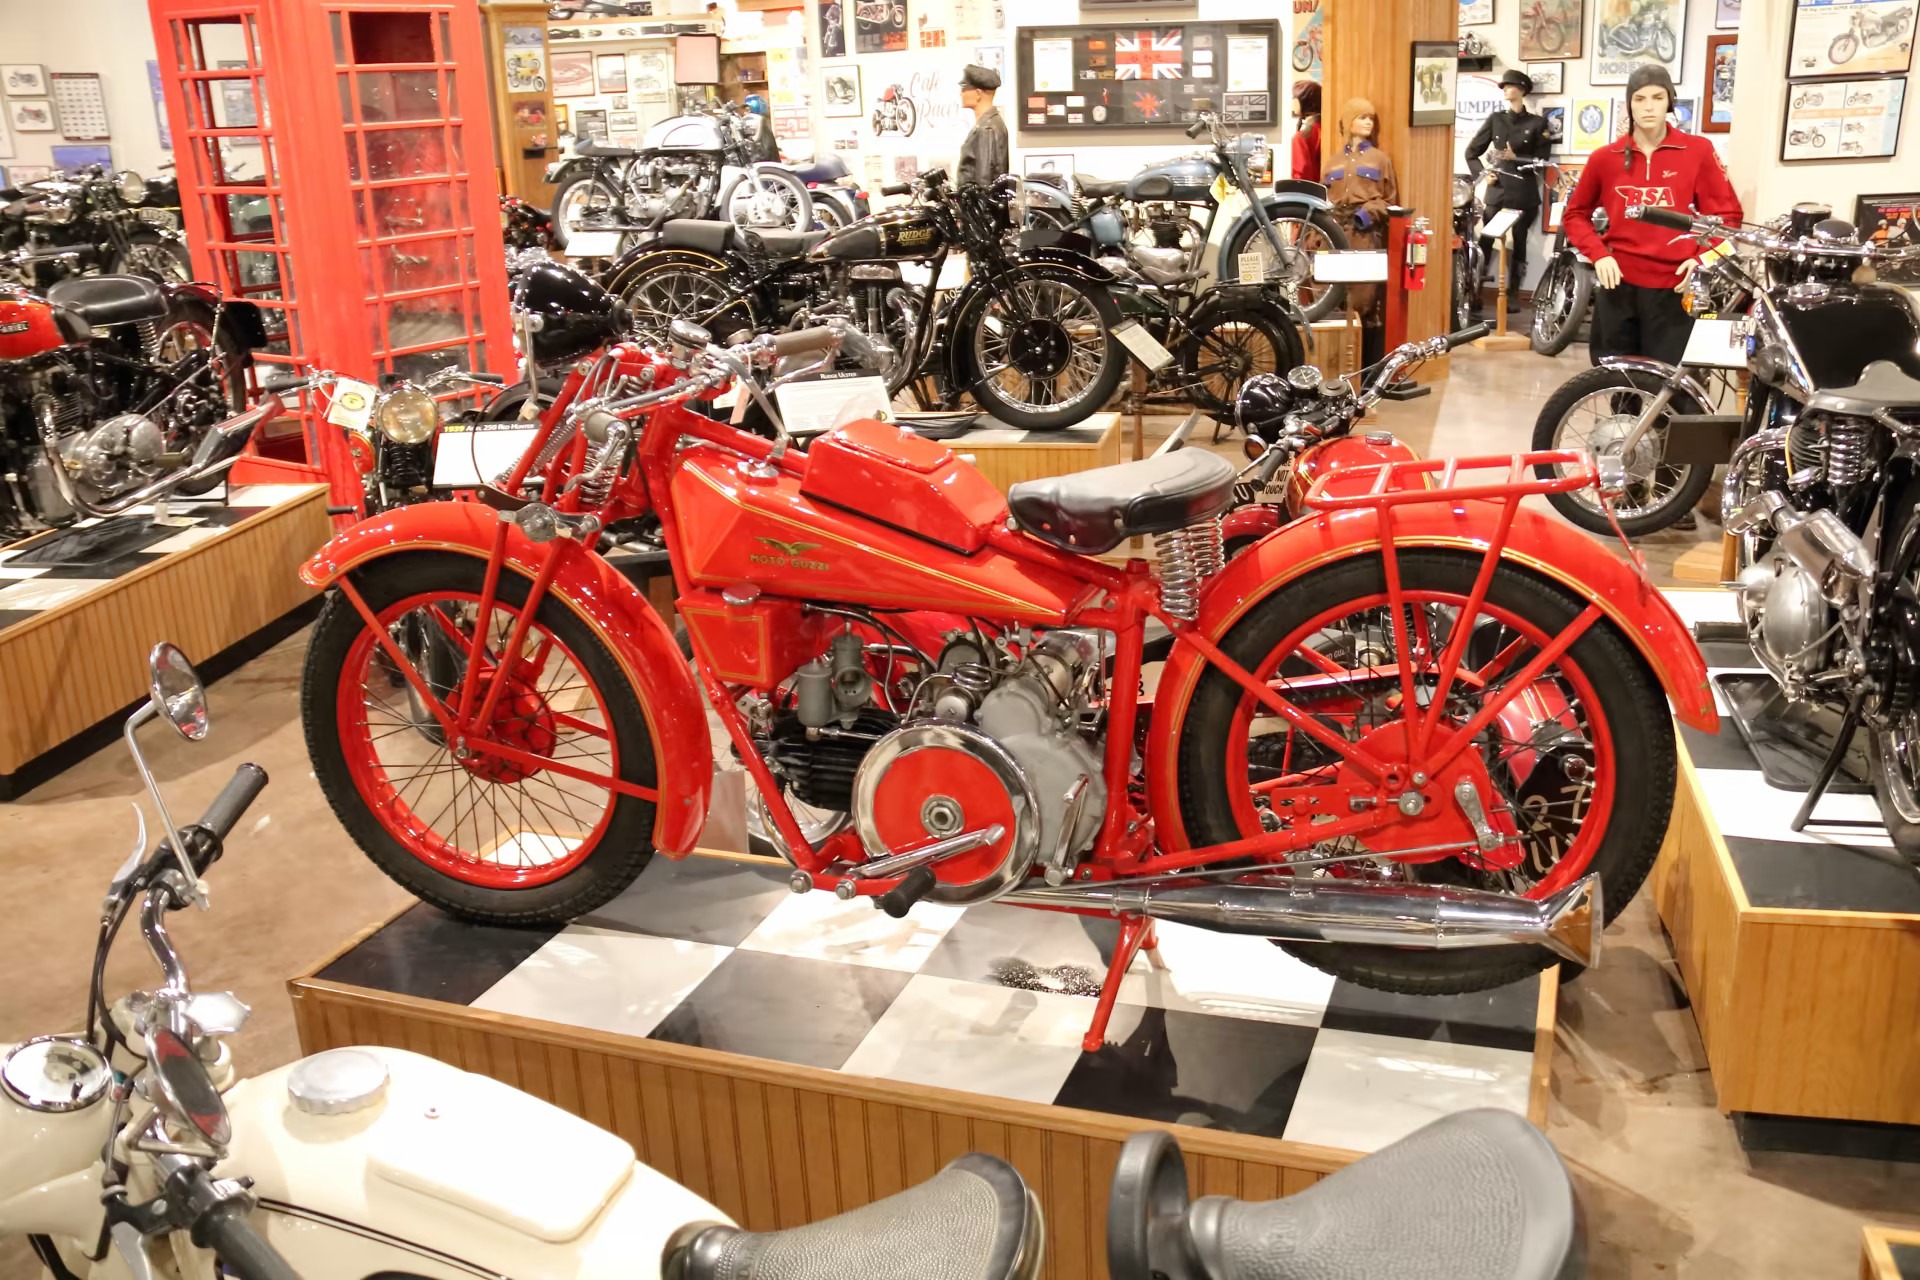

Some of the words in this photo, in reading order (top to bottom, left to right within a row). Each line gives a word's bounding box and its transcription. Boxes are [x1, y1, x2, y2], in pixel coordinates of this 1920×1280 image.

[1626, 187, 1673, 206] BSA
[897, 227, 935, 242] RUDGE
[1240, 255, 1260, 263] PLEASE
[444, 425, 465, 433] 1939
[483, 423, 497, 431] 250
[1275, 469, 1290, 483] NOT
[1261, 484, 1285, 495] TOUCH
[749, 554, 786, 567] MOTO
[790, 558, 831, 571] GUZZI
